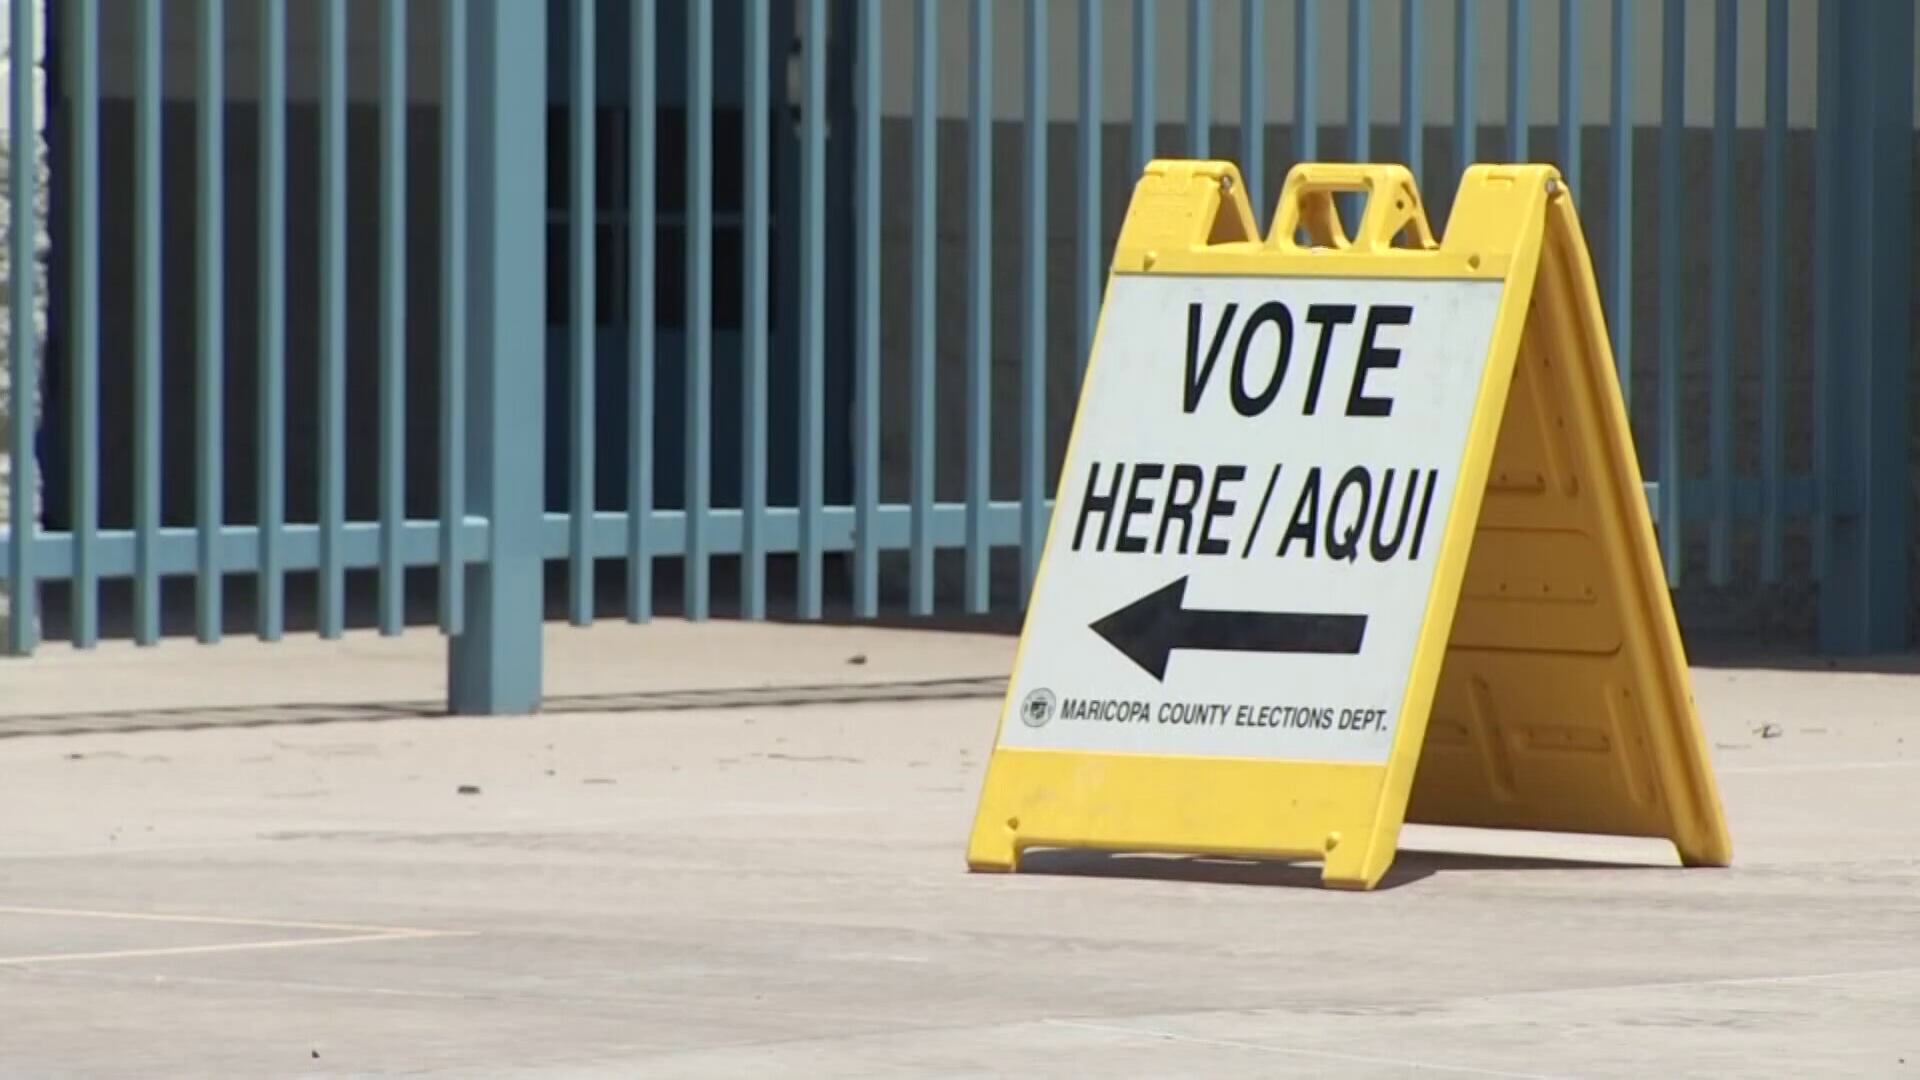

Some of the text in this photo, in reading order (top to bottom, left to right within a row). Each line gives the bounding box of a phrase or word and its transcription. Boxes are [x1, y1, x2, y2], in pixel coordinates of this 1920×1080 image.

[1183, 301, 1414, 418] VOTE
[1060, 698, 1388, 732] MARICOPA COUNTY ELECTIONS DEPT.
